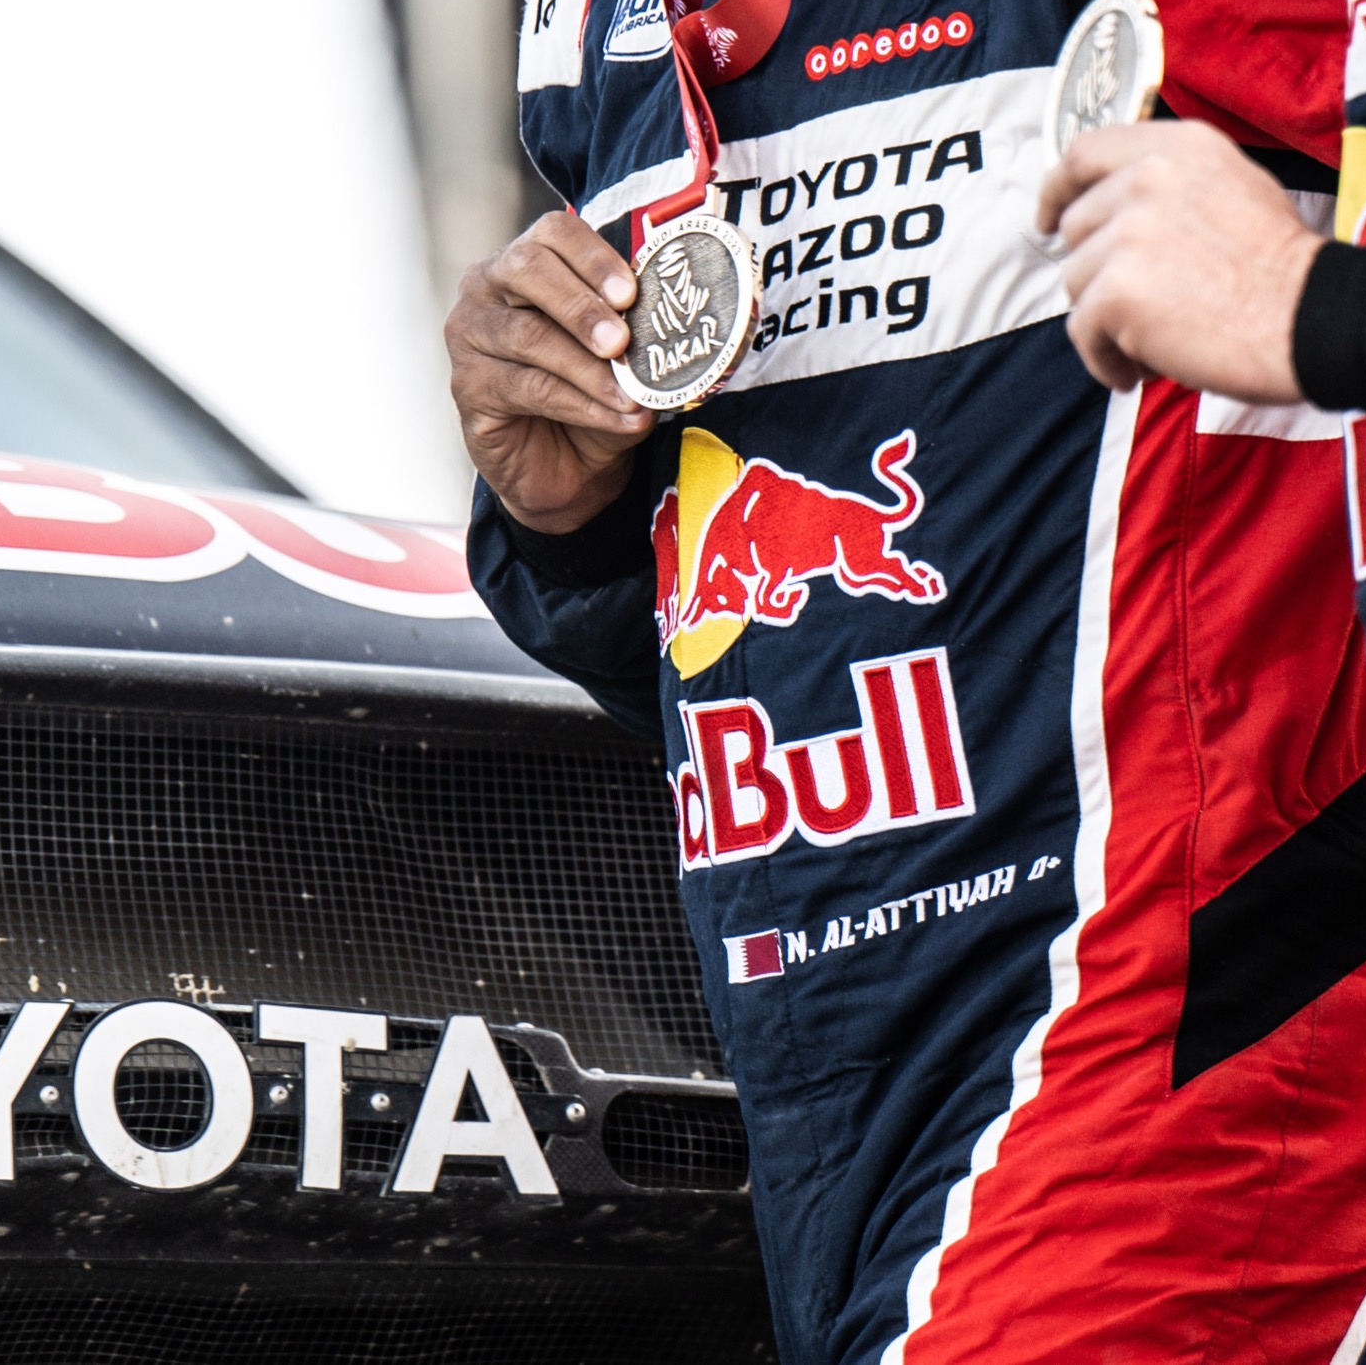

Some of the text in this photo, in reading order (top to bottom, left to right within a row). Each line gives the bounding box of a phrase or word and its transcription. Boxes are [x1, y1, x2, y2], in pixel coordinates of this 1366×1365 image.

[808, 16, 970, 76] ooredoo
[713, 129, 984, 227] TOYOTA
[646, 315, 725, 382] DAKAR
[751, 275, 931, 352] acing
[693, 655, 966, 855] Bull
[783, 930, 816, 964] N.
[821, 864, 1017, 953] AL-ATTIYAH
